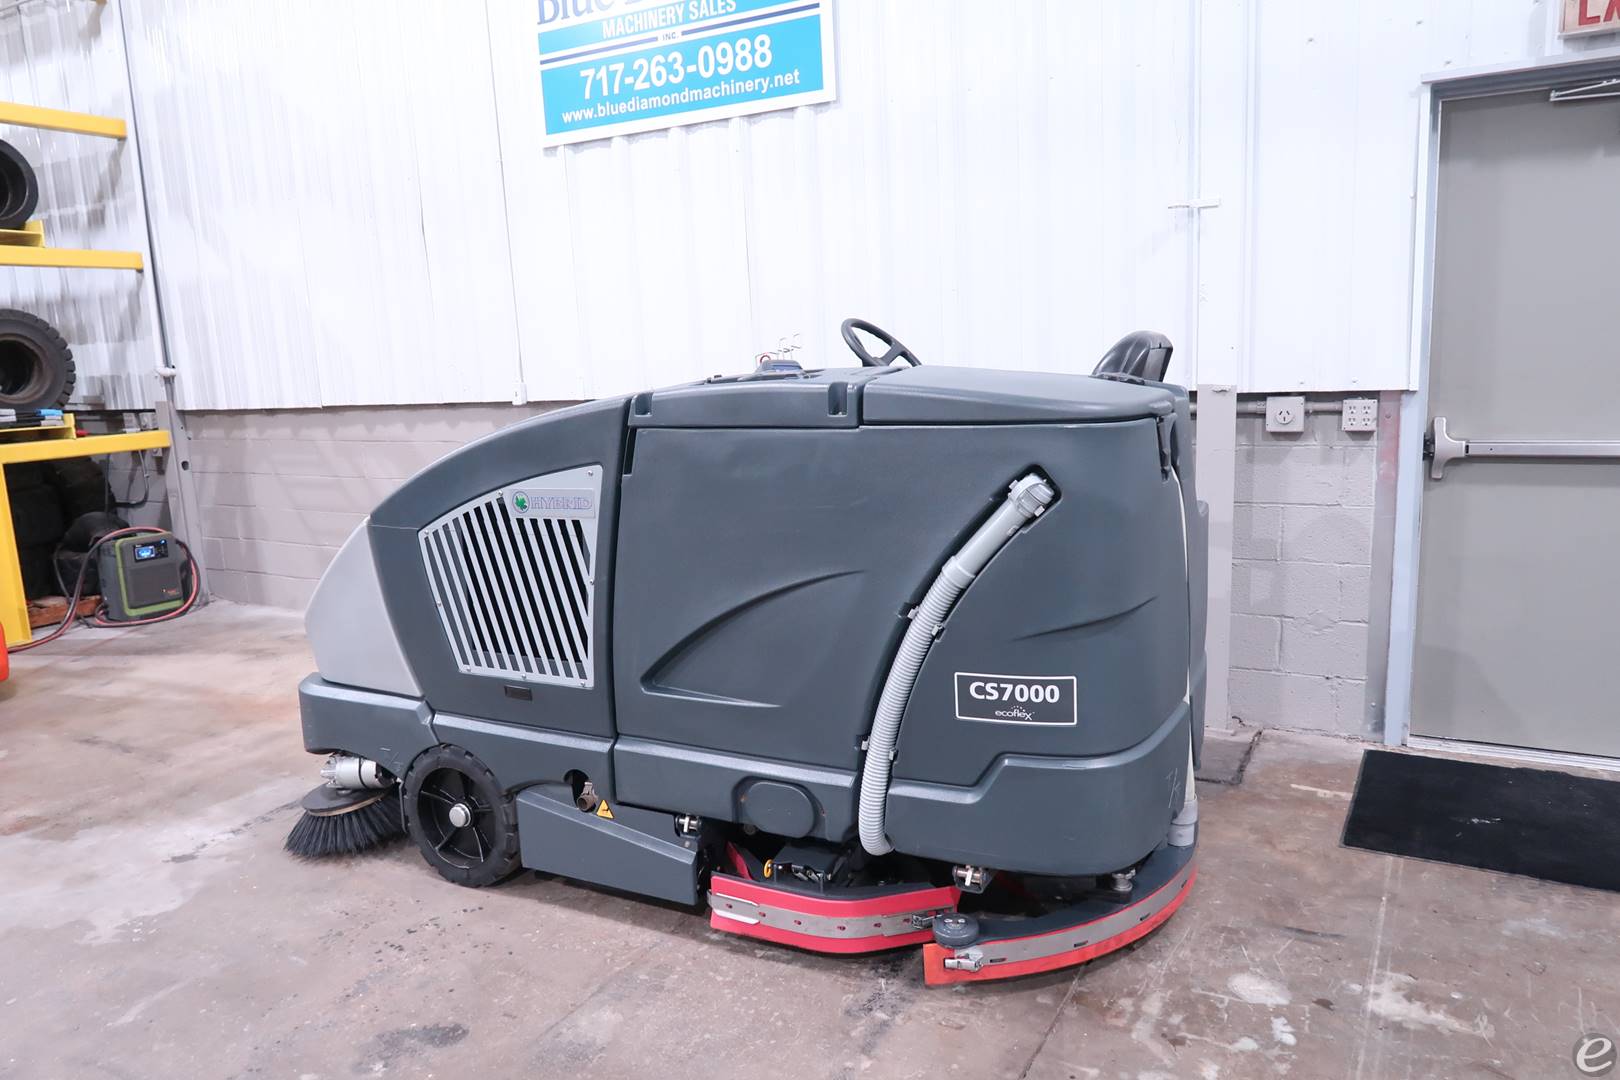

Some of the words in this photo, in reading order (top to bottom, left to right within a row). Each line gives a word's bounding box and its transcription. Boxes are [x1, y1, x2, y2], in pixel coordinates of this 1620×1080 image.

[602, 3, 685, 39] MACHINERY
[689, 0, 736, 20] SALES
[580, 34, 773, 100] 717-263-0988
[562, 68, 801, 123] www.bluediamondmachinery.net
[969, 681, 1061, 703] CS7000
[995, 708, 1033, 721] ecoflex
